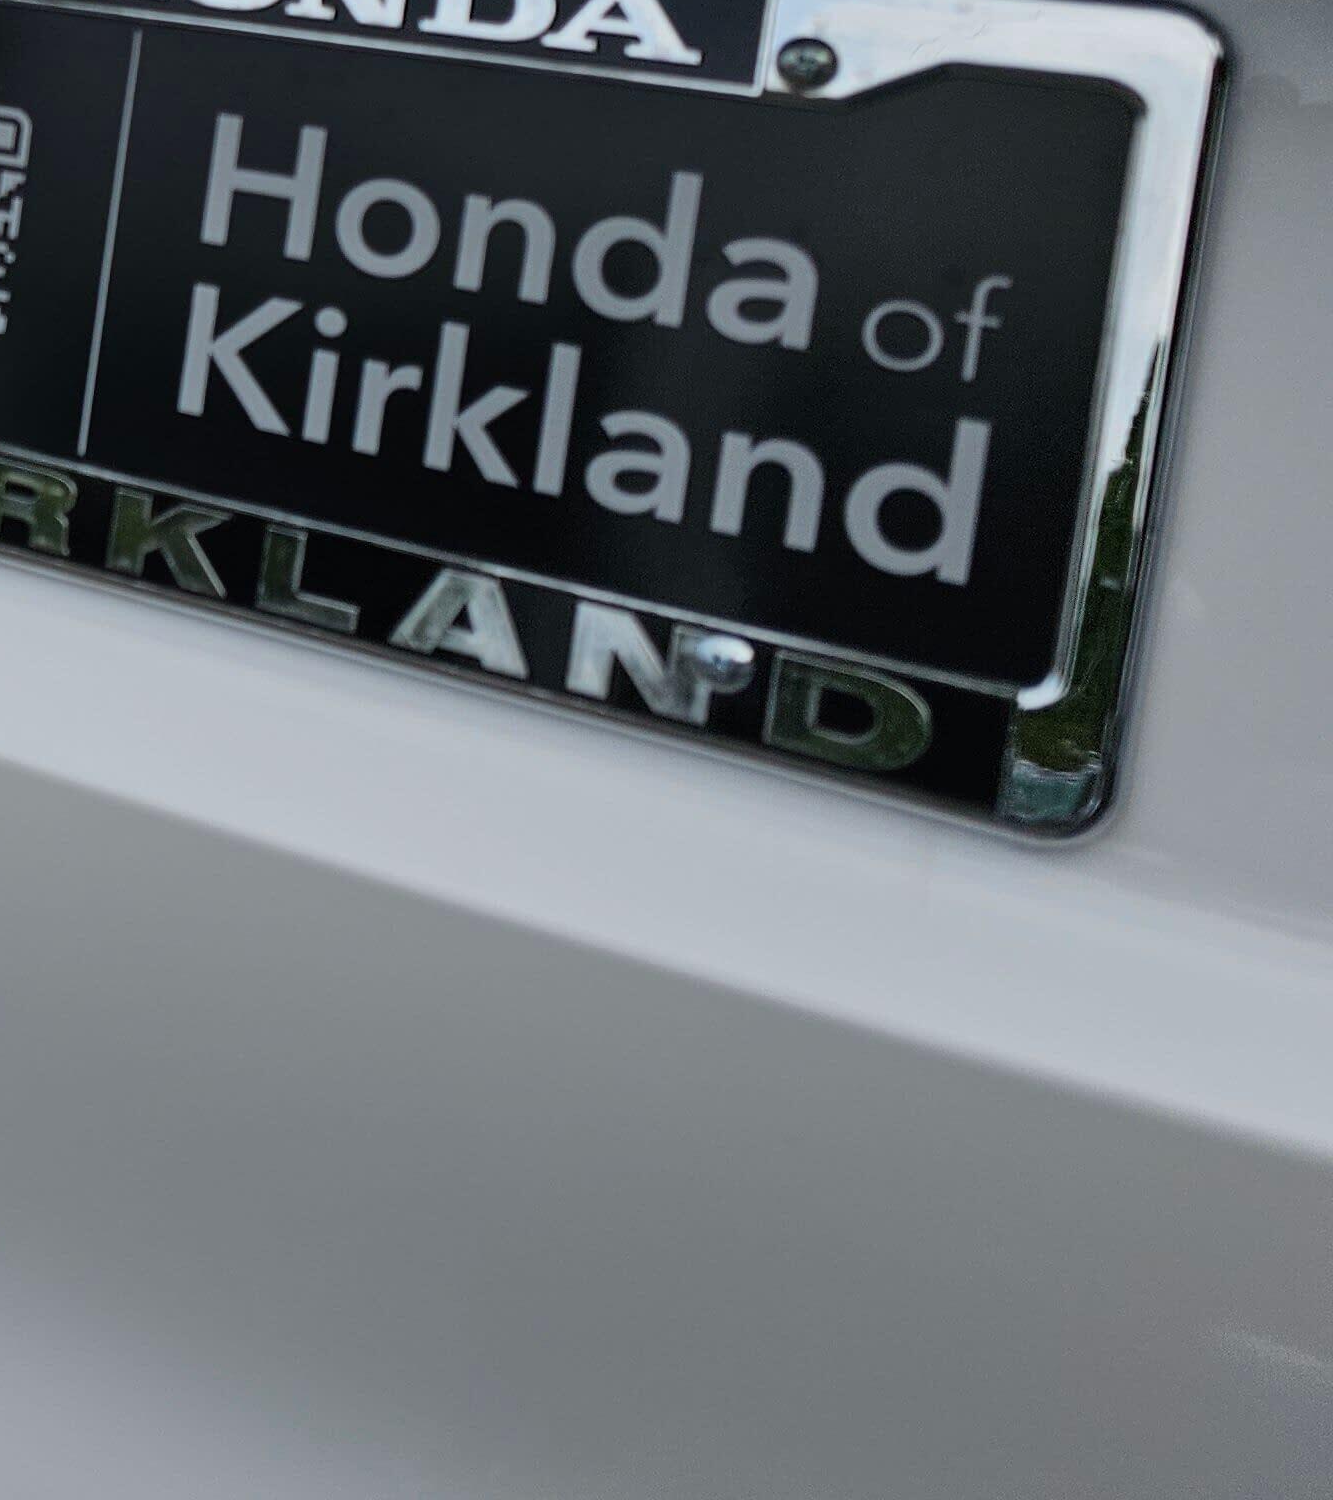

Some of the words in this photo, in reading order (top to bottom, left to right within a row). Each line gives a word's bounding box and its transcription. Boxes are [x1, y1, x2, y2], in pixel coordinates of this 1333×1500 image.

[199, 112, 821, 351] Honda
[861, 274, 1014, 382] of
[175, 283, 993, 588] Kirkland
